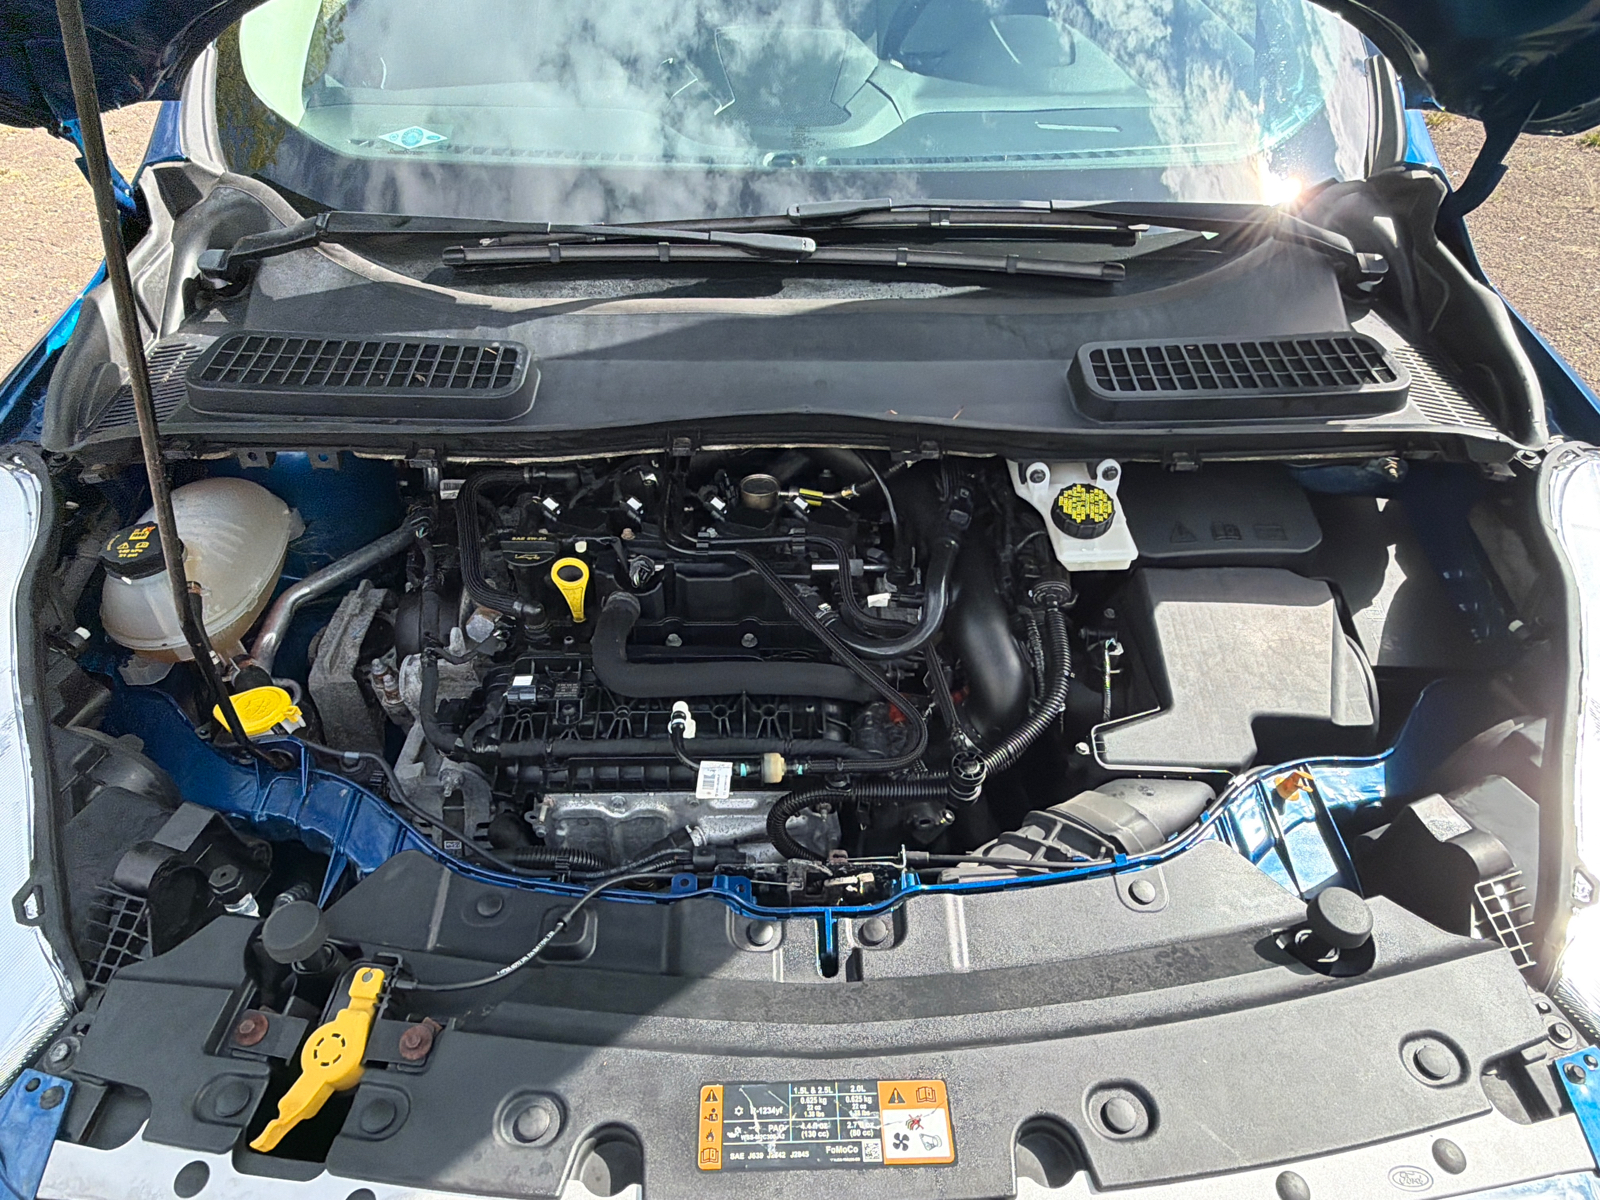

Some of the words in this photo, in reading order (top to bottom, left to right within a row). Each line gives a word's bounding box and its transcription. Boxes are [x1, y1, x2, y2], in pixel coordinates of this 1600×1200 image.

[793, 1086, 809, 1095] 1.5L
[810, 1086, 817, 1094] &
[817, 1085, 833, 1094] 2.5L
[850, 1084, 866, 1093] 2.0L
[800, 1096, 818, 1104] 0.625
[818, 1096, 828, 1105] kg
[845, 1095, 863, 1103] 0.625
[863, 1095, 873, 1104] kg
[801, 1130, 817, 1139] (130
[817, 1130, 830, 1139] cc)
[862, 1129, 874, 1138] cc)
[825, 1145, 859, 1154] FoMoCo
[730, 1152, 745, 1160] SAE
